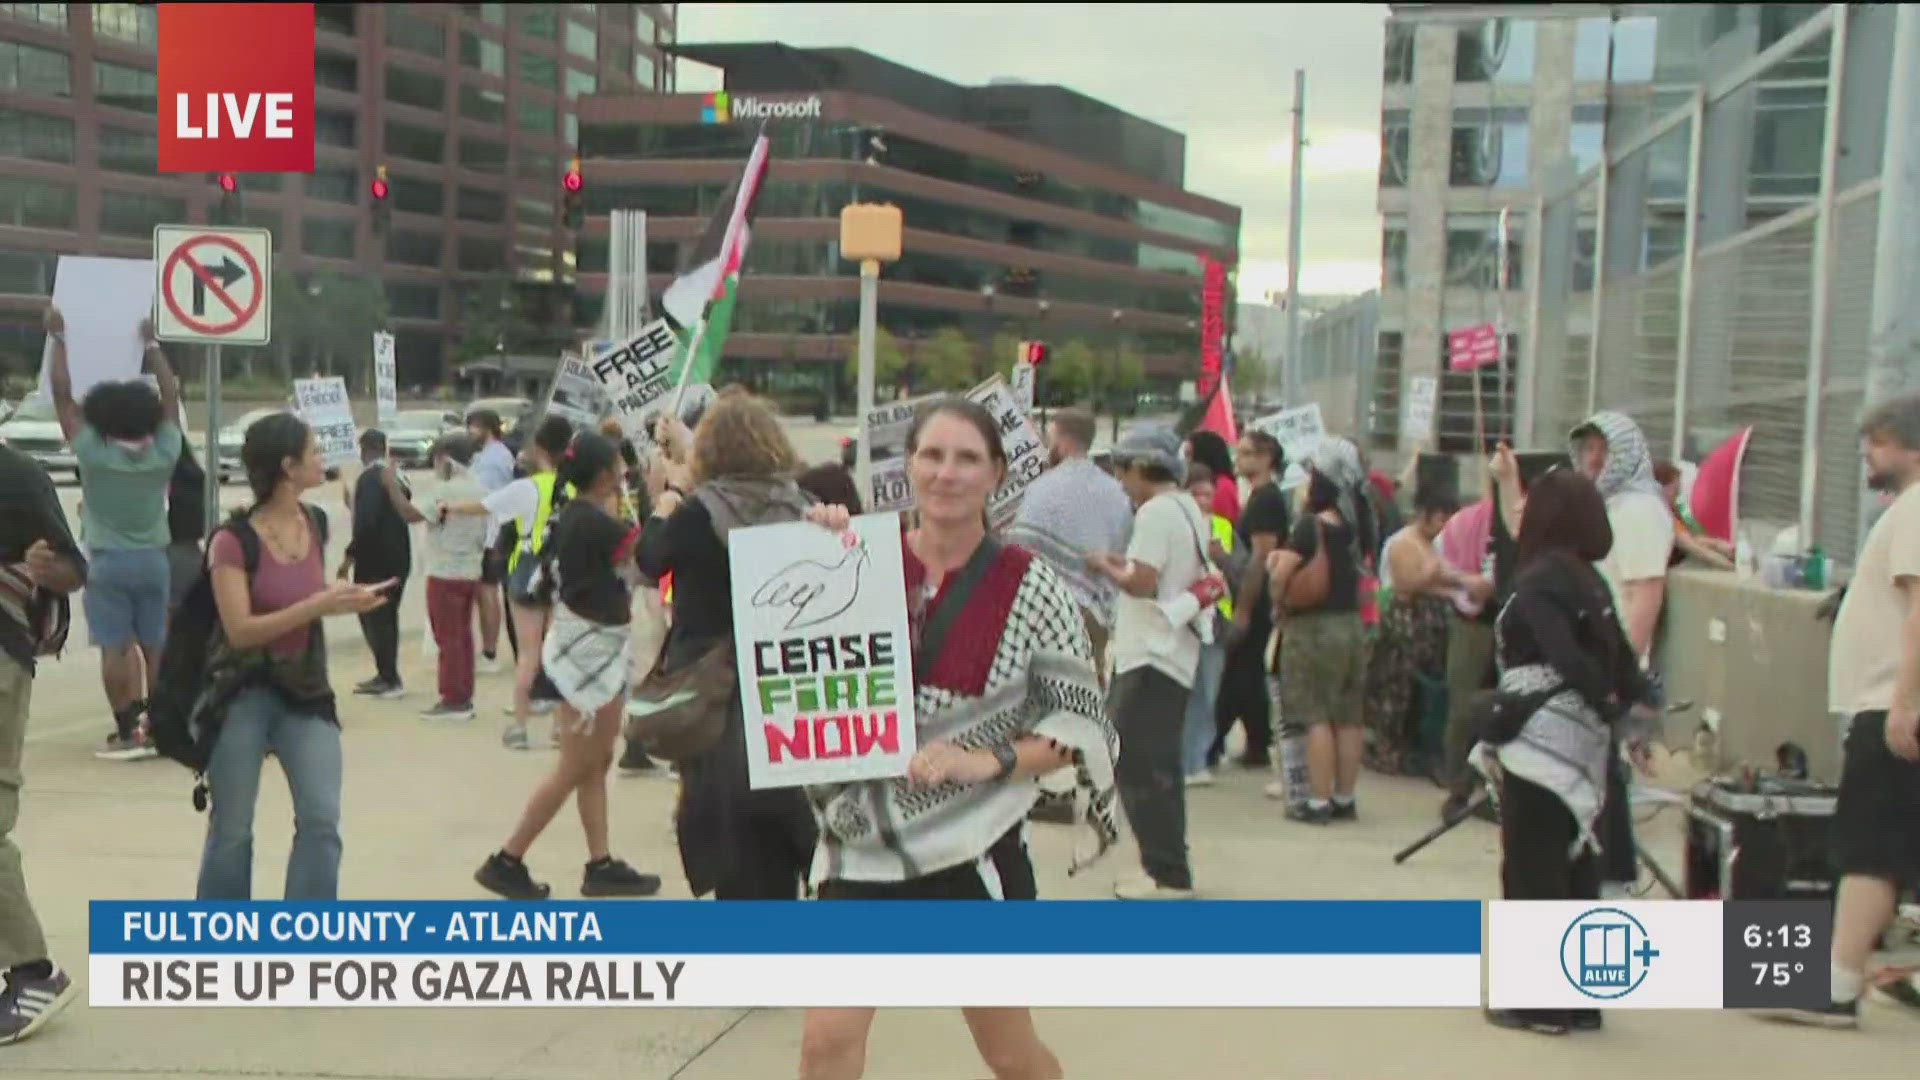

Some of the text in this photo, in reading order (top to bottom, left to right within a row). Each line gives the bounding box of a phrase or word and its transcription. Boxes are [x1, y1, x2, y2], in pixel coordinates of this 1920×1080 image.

[732, 95, 821, 118] Microsoft
[592, 325, 673, 385] FREE
[626, 360, 669, 389] ALL
[754, 631, 895, 677] CEASE
[763, 711, 900, 764] NOW
